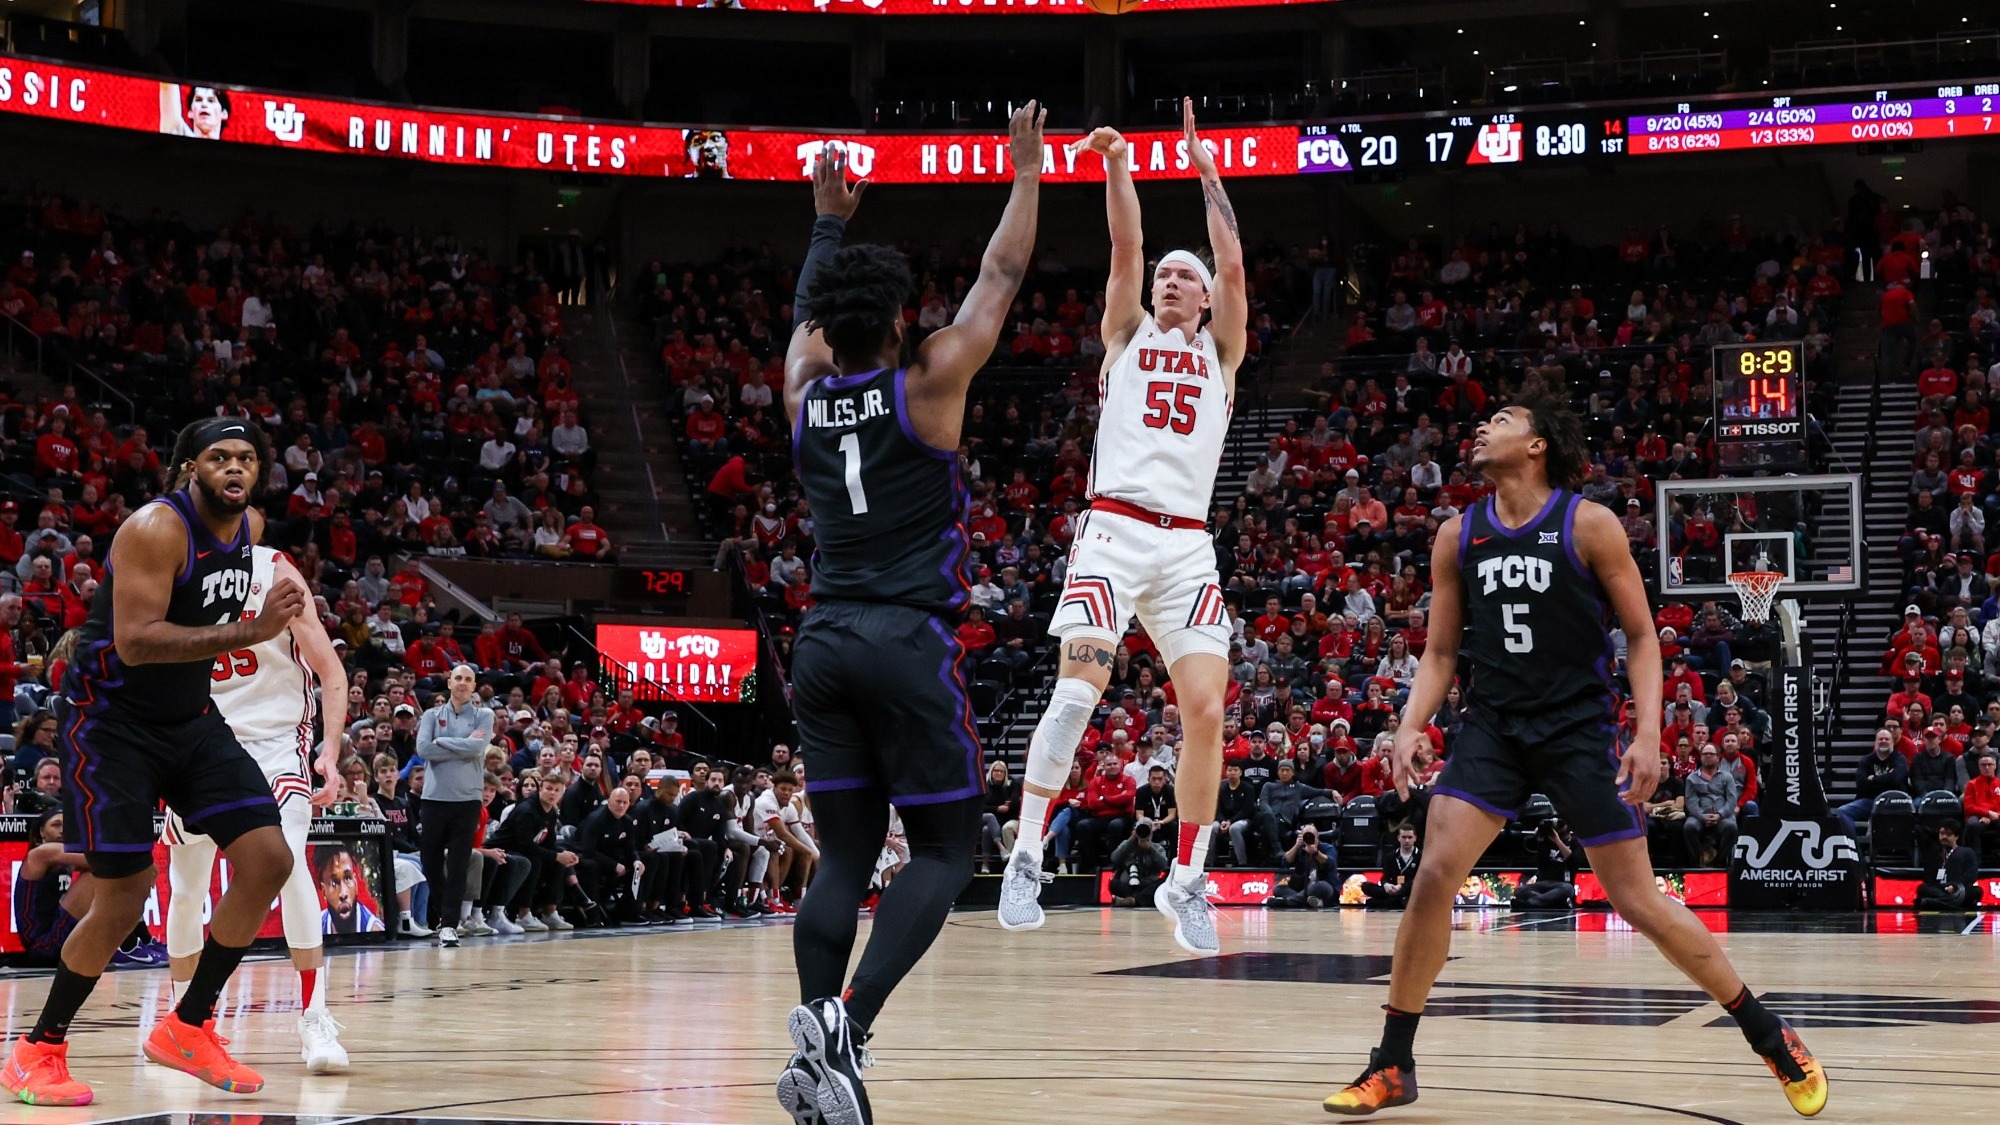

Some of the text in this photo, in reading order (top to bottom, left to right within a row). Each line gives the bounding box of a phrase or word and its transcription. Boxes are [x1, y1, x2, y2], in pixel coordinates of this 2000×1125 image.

[1876, 91, 1887, 101] FT
[1938, 87, 1963, 98] OREB
[1975, 84, 1999, 96] DREB
[1677, 104, 1690, 114] FG
[1773, 97, 1790, 108] 3PT
[1852, 102, 1912, 119] 0/2 (0%)
[1945, 100, 1955, 113] 3
[1982, 98, 1992, 112] 2
[1451, 117, 1473, 127] 4 TOL
[1492, 114, 1515, 124] 4 FLS
[1647, 114, 1722, 132] 9/20 (45%)
[1748, 108, 1816, 126] 2/4 (50%)
[1982, 117, 1992, 131] 7
[1312, 126, 1327, 135] FLS
[1340, 124, 1362, 133] 4 TOL
[1604, 119, 1622, 136] 14
[1852, 121, 1913, 138] 0/0 (0%)
[1947, 119, 1954, 133] 1
[349, 117, 626, 169] RUNNIN' UTES
[1536, 123, 1586, 156] 8:30
[1648, 133, 1720, 150] 8/13 (62%)
[1750, 127, 1815, 144] 1/3 (33%)
[1297, 139, 1349, 169] TCU
[1361, 136, 1397, 166] 20
[1426, 132, 1454, 162] 17
[1601, 138, 1623, 153] 1ST
[922, 137, 1258, 174] HOLIAY LASSIC
[1741, 350, 1792, 375] 8:29
[1750, 378, 1786, 413] 14
[807, 388, 890, 428] MILES JR.
[1142, 381, 1203, 436] 55
[1742, 422, 1800, 436] TISSOT
[838, 432, 869, 515] 1
[641, 570, 684, 593] 7:29
[1477, 555, 1553, 596] TCU
[202, 568, 249, 608] TCU
[1501, 603, 1533, 653] 5
[677, 634, 720, 659] TCU
[627, 662, 731, 686] HOLIDAY
[1783, 673, 1800, 806] AMERICA FIRST
[0, 818, 28, 833] vivint
[314, 821, 335, 834] vivint
[1740, 869, 1847, 881] AMERICA FIRST
[1241, 881, 1269, 895] TCU
